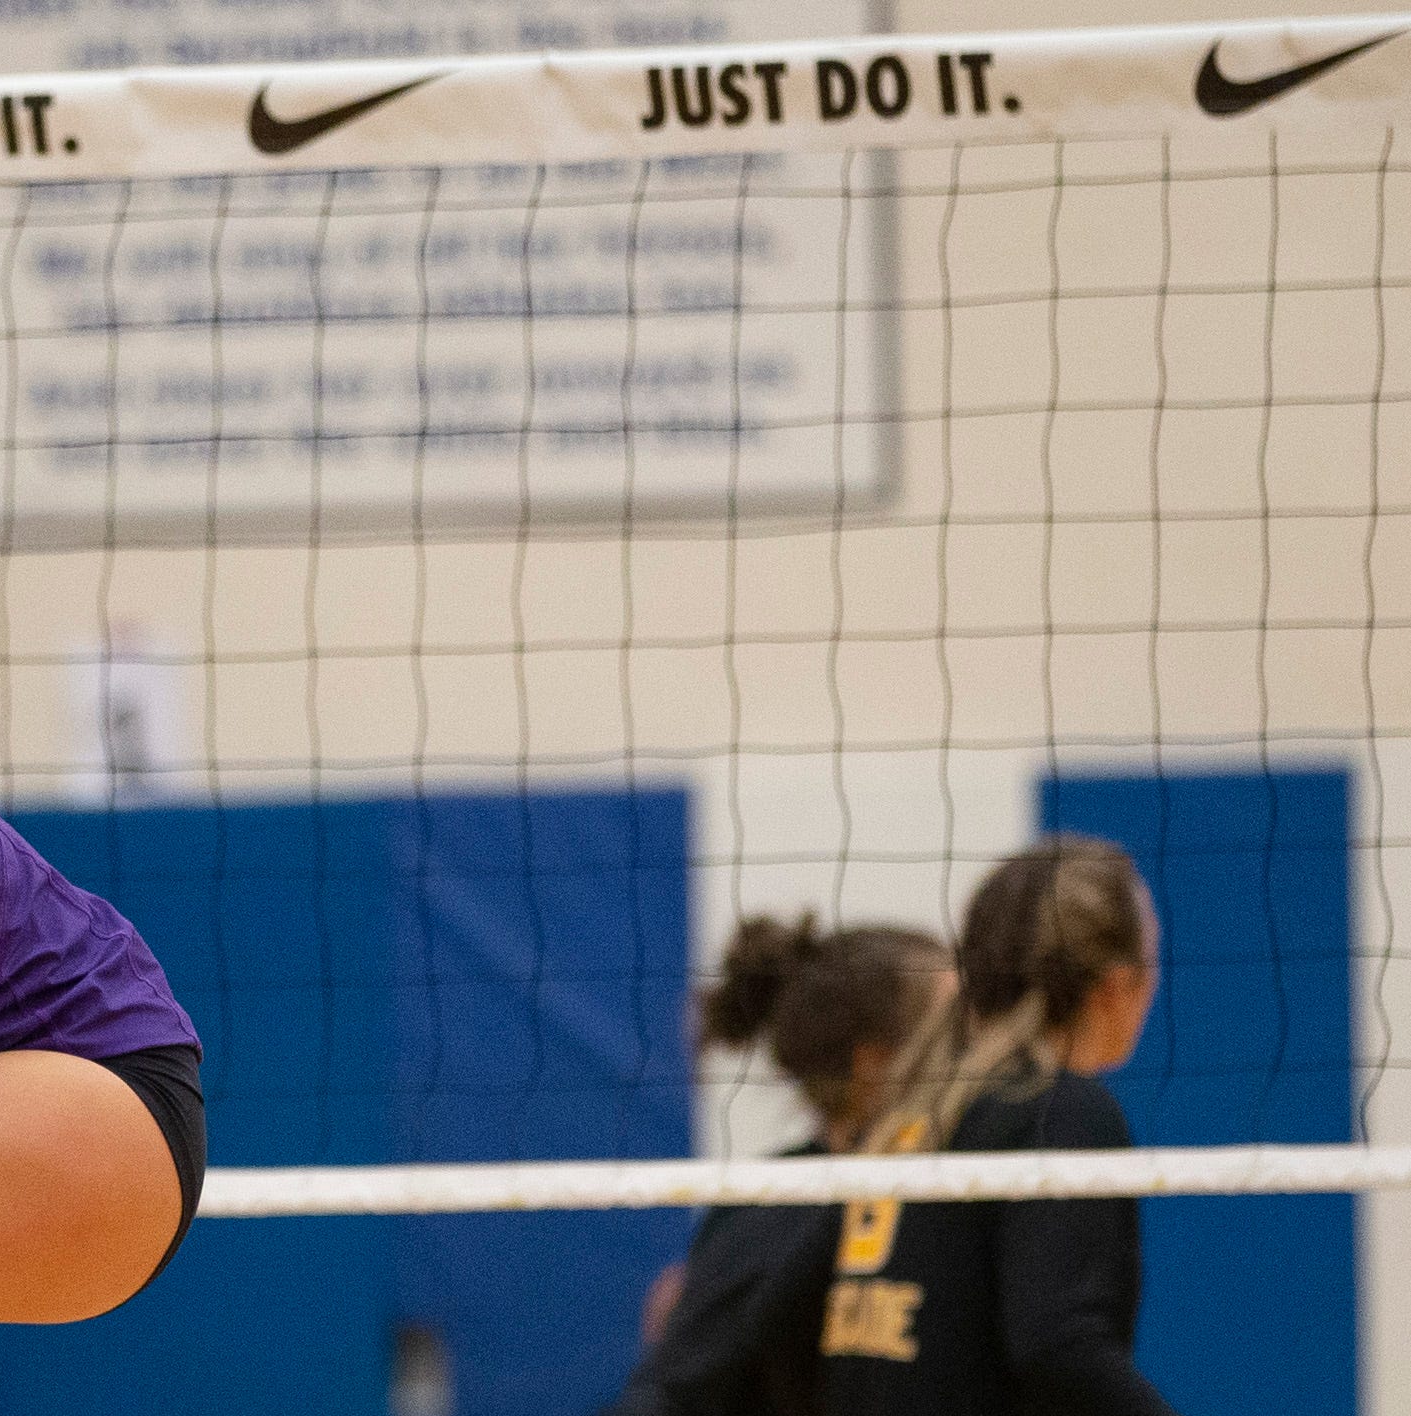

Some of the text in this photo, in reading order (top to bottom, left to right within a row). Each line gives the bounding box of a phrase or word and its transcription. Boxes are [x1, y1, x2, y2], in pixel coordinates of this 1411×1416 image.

[1, 94, 78, 155] IT.
[640, 52, 1022, 131] JUST DO IT.
